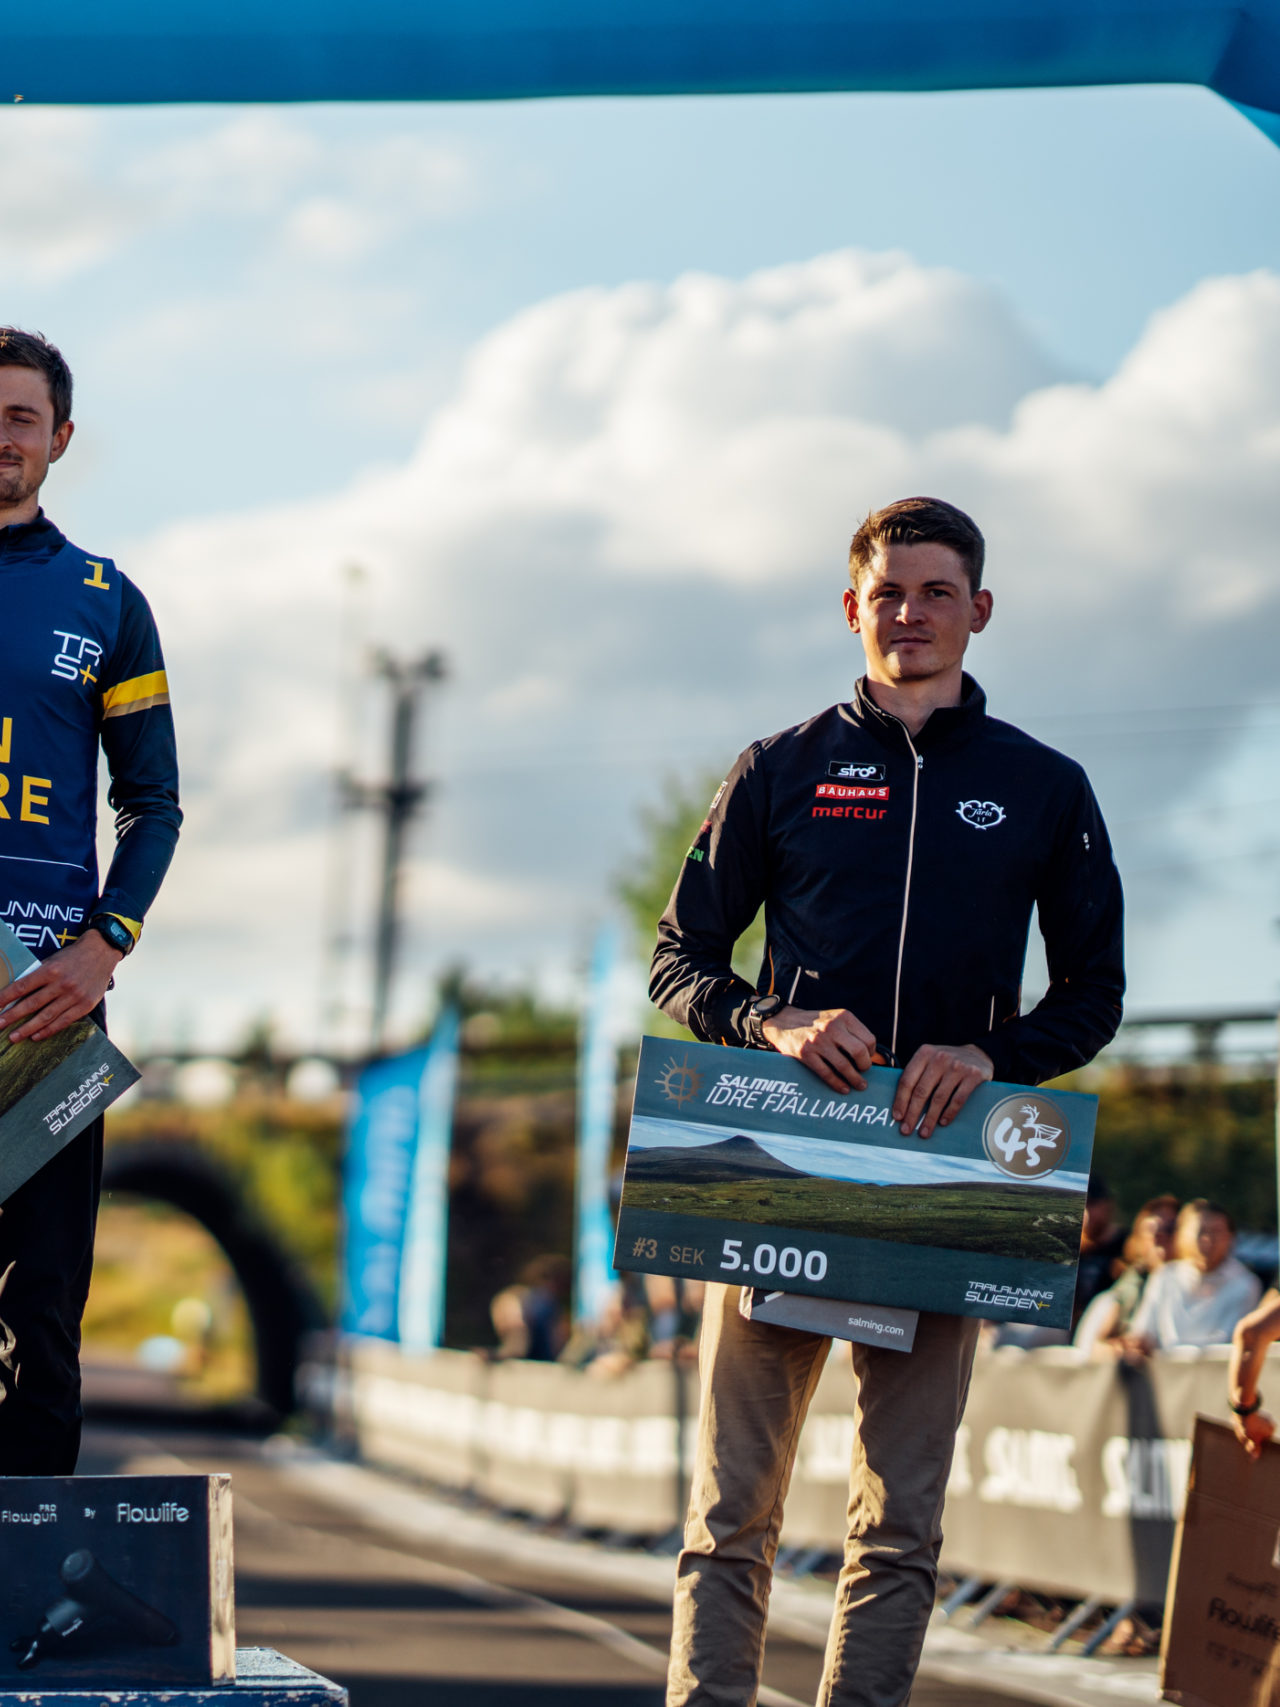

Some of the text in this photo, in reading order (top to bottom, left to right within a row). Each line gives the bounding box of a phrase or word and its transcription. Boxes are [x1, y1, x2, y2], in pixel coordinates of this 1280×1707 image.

[83, 560, 110, 590] 1
[818, 786, 887, 797] BAUHAUS
[811, 805, 888, 820] mercur
[42, 1062, 110, 1123] TRAILRUNNING
[706, 1086, 763, 1110] IDRE
[632, 1237, 828, 1281] #3 SEK 5.000
[968, 1280, 1054, 1300] TRAILRUNNING
[848, 1316, 905, 1336] salming.com
[1, 1502, 190, 1525] Flowgun By Flowlife
[39, 1504, 57, 1512] PRO
